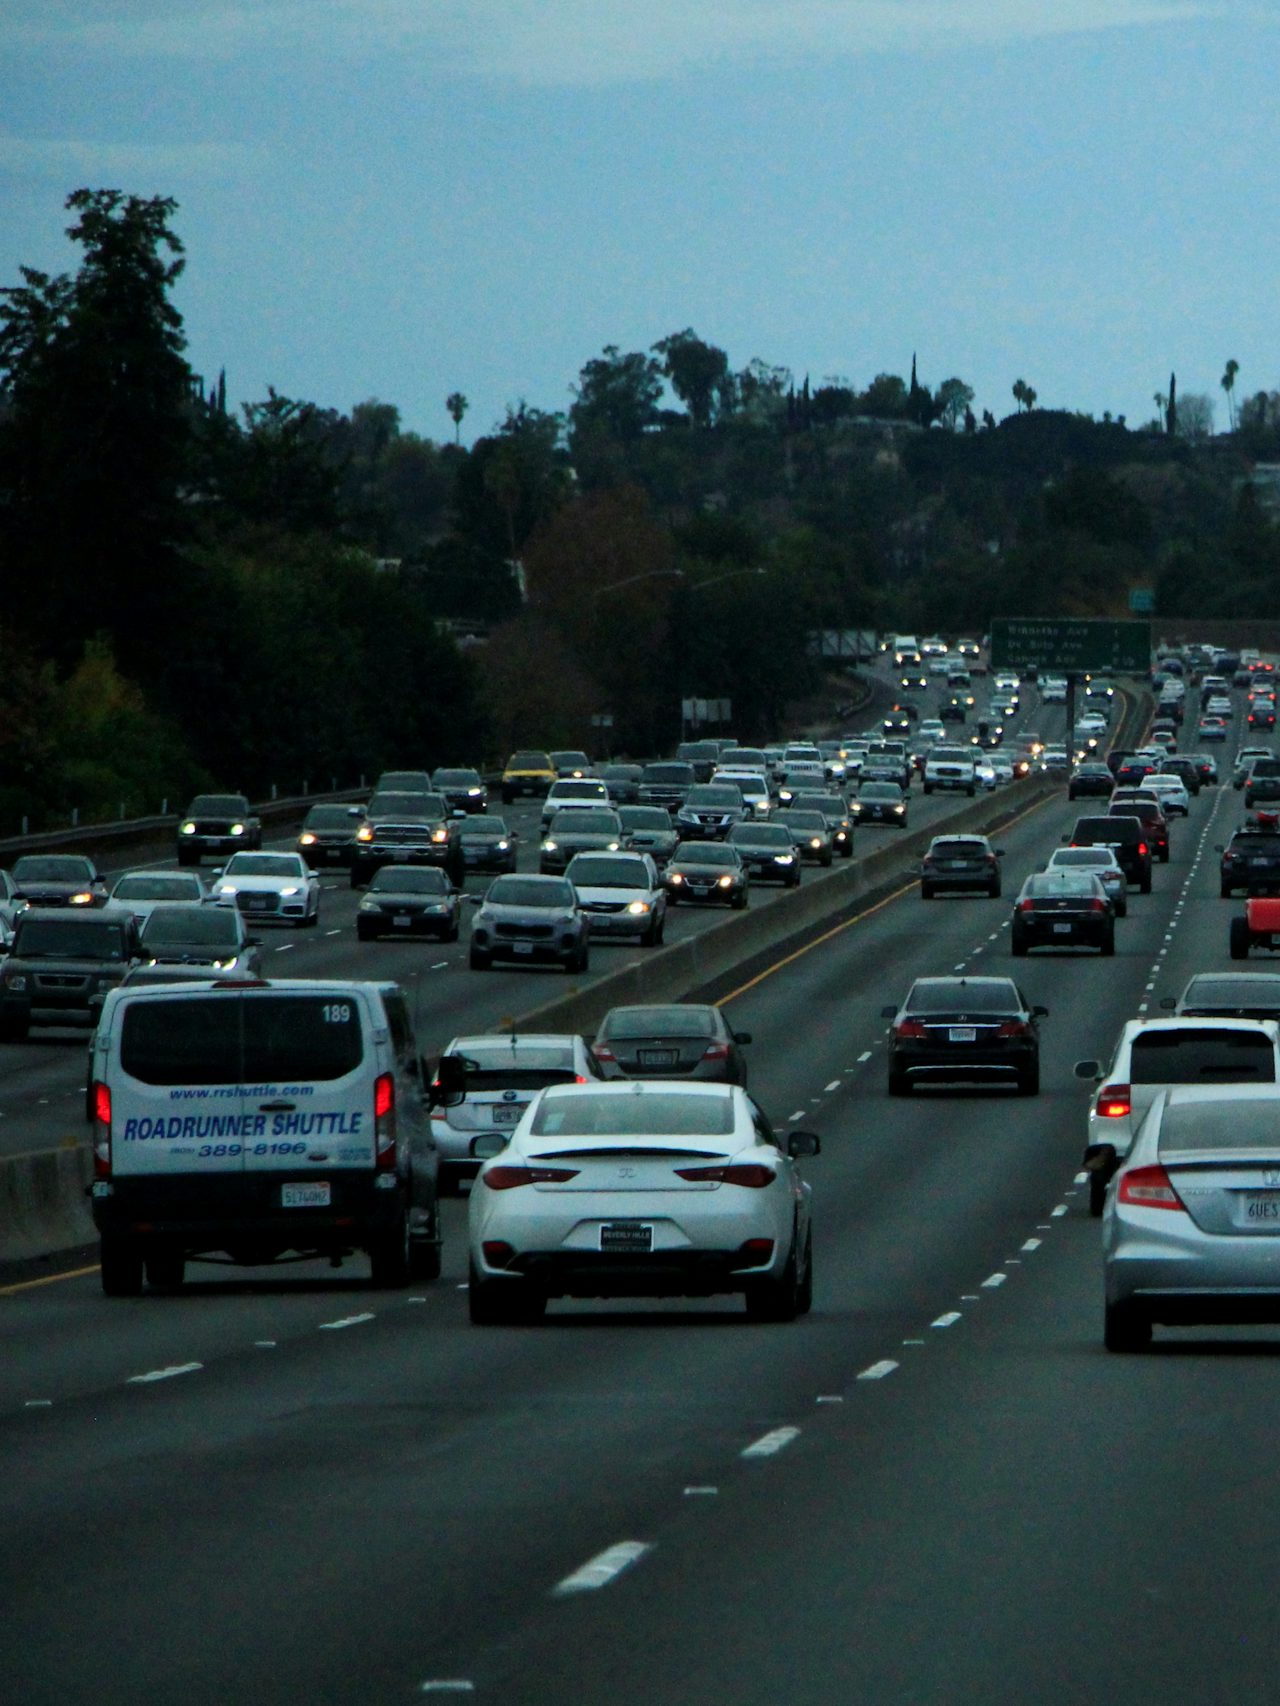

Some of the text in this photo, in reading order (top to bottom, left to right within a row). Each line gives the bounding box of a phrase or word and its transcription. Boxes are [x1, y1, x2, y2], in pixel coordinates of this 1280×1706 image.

[322, 1004, 350, 1022] 189
[170, 1084, 314, 1100] www.rrshuttle.com
[124, 1111, 362, 1141] ROADRUNNER SHUTTLE
[197, 1141, 308, 1158] 389-8196
